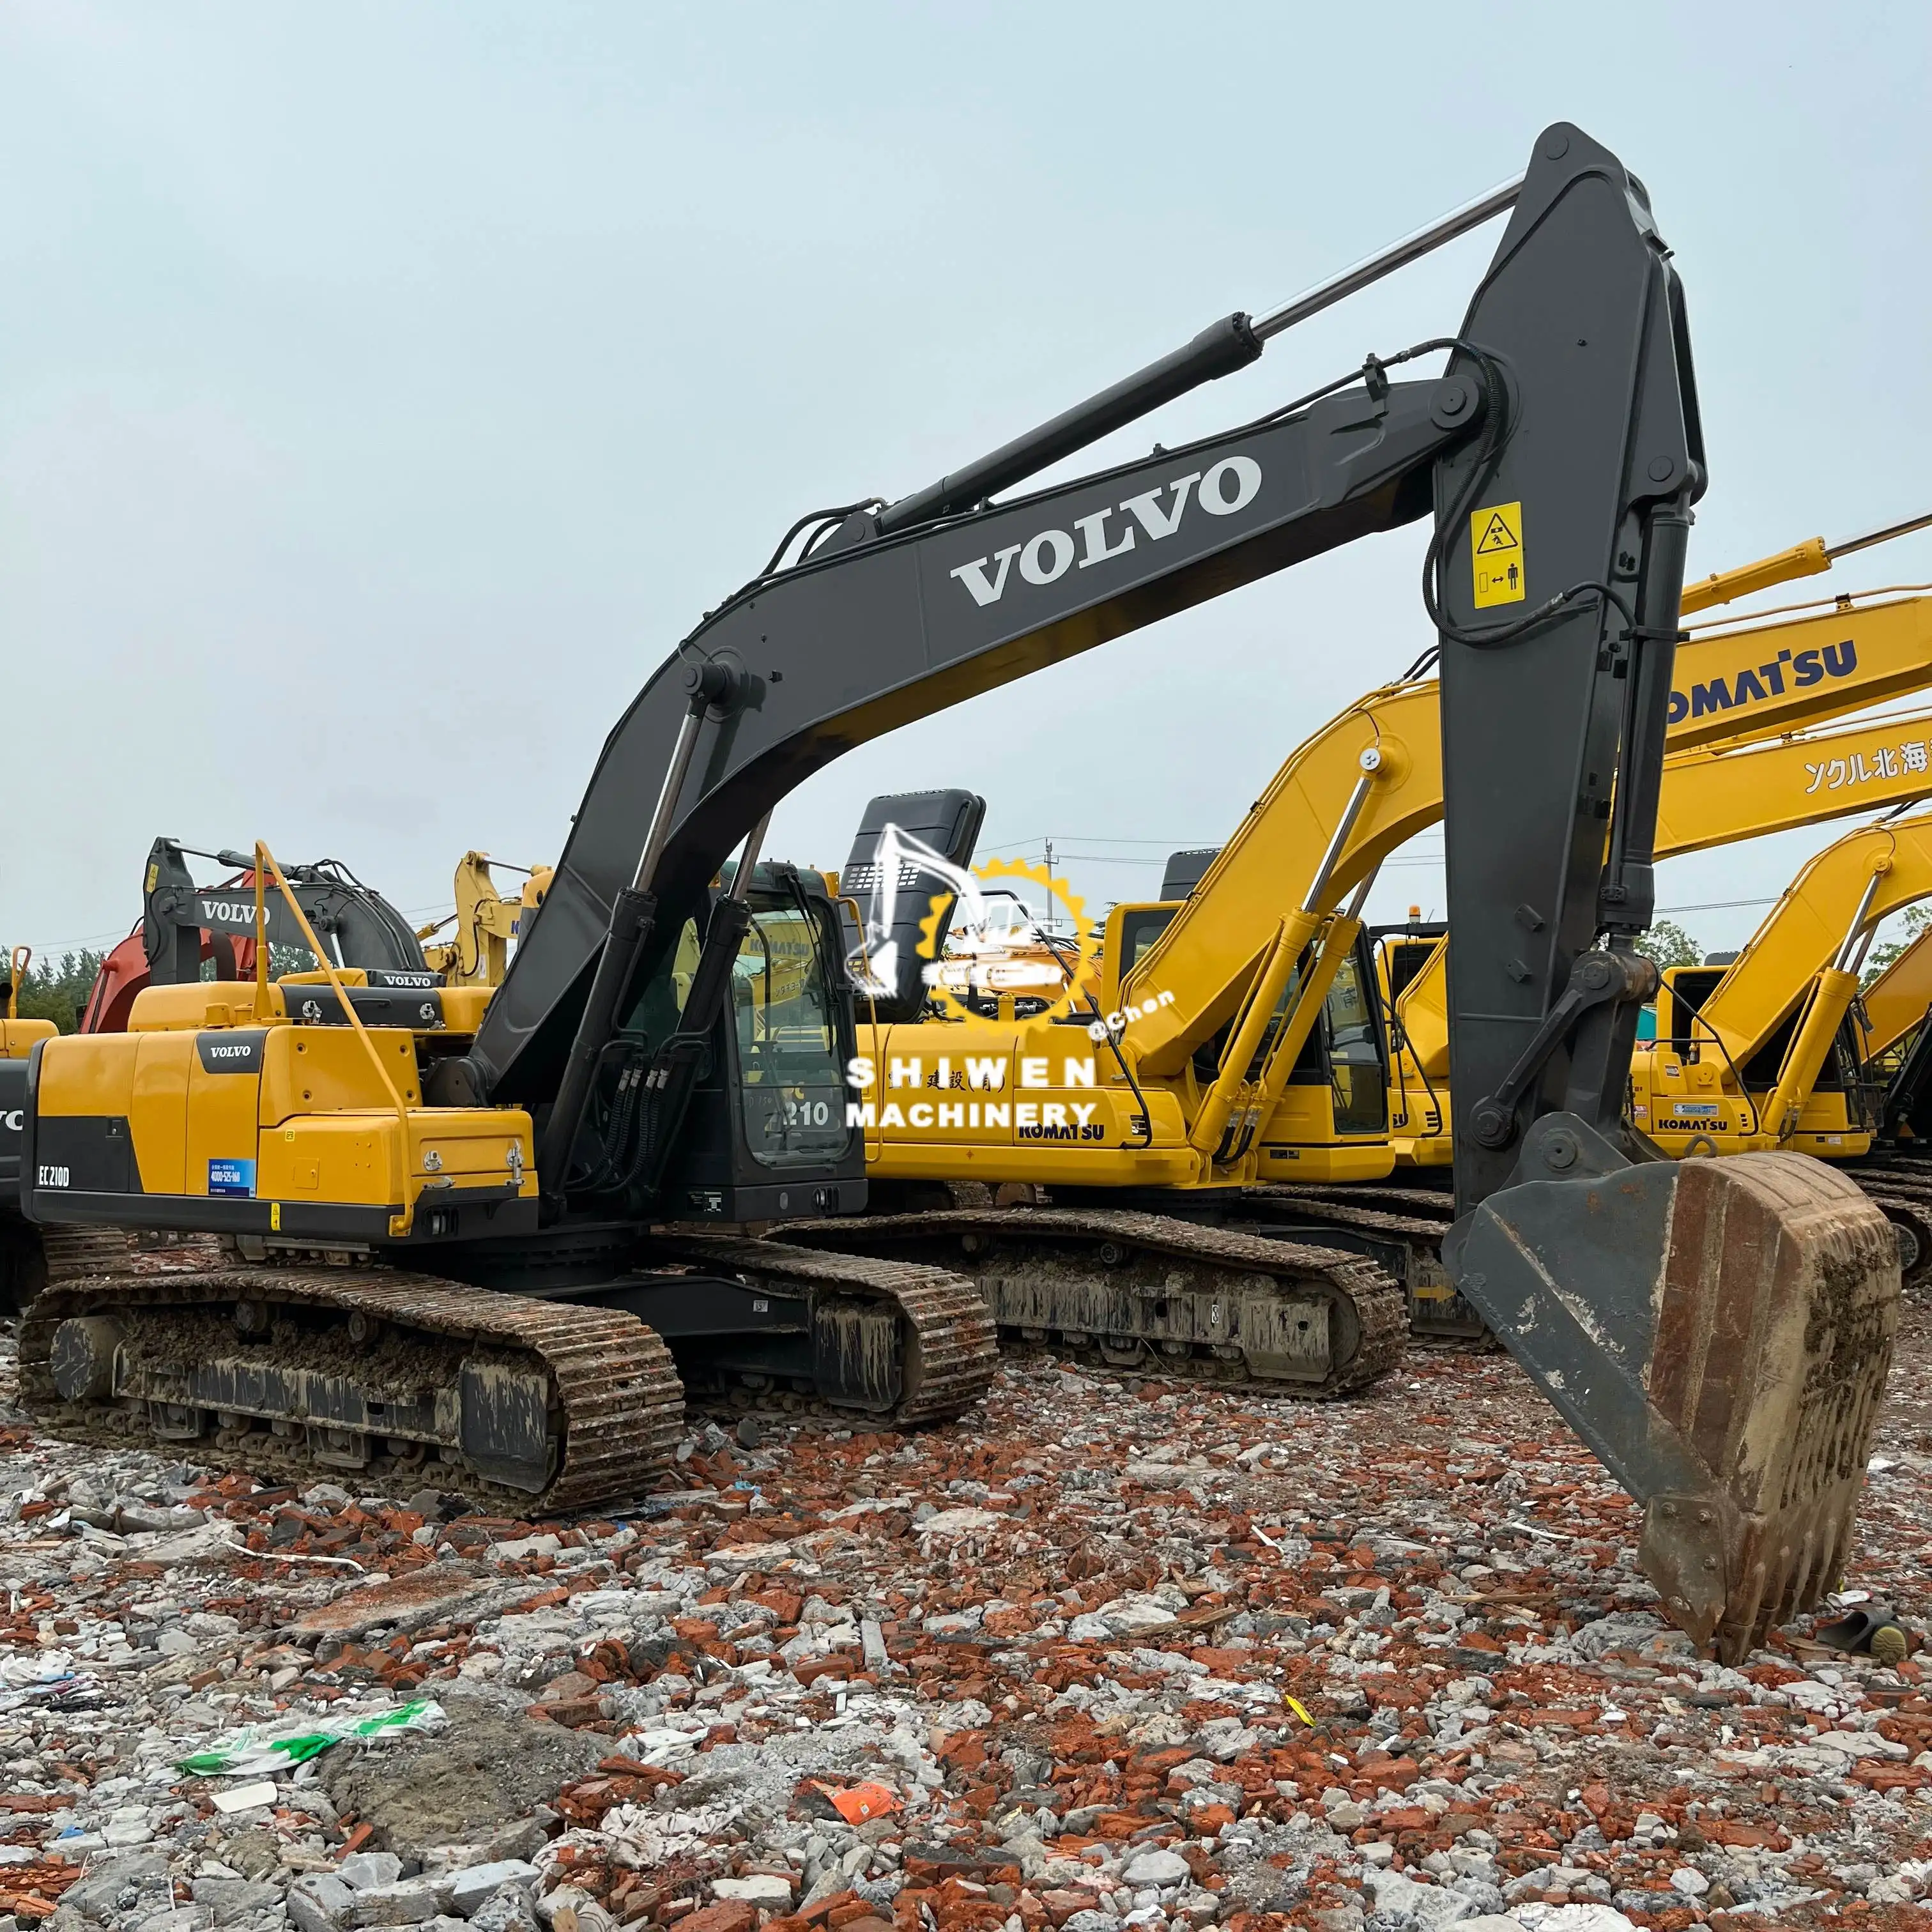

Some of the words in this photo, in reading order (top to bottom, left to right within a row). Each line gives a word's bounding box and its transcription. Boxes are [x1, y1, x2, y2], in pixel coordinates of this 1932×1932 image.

[950, 456, 1262, 607] VOLVO
[384, 976, 431, 987] VOLVO
[210, 1045, 251, 1057] VOLVO
[1019, 1121, 1104, 1140] KOMATSU
[1658, 1118, 1728, 1131] KOMATSU
